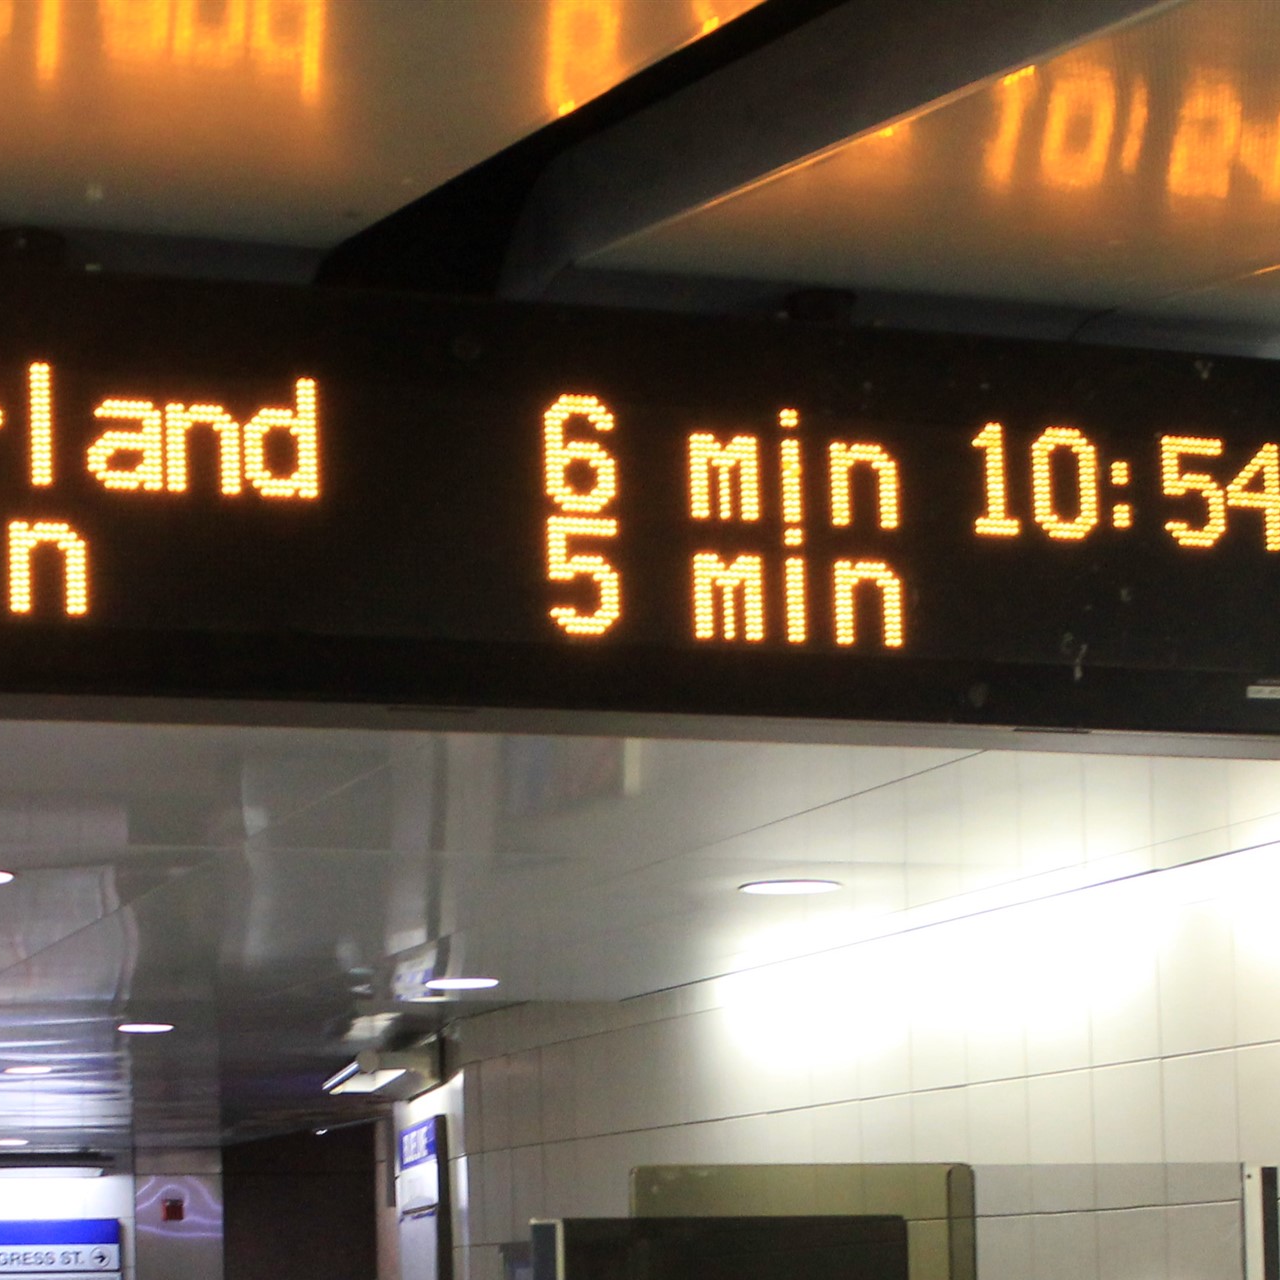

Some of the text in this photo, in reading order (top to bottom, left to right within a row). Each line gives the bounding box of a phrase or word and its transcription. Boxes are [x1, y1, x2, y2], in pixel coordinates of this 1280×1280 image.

[541, 393, 616, 513] 6
[686, 407, 901, 531] min
[545, 516, 622, 638] 5
[691, 526, 906, 649] min
[60, 1250, 85, 1265] ST.
